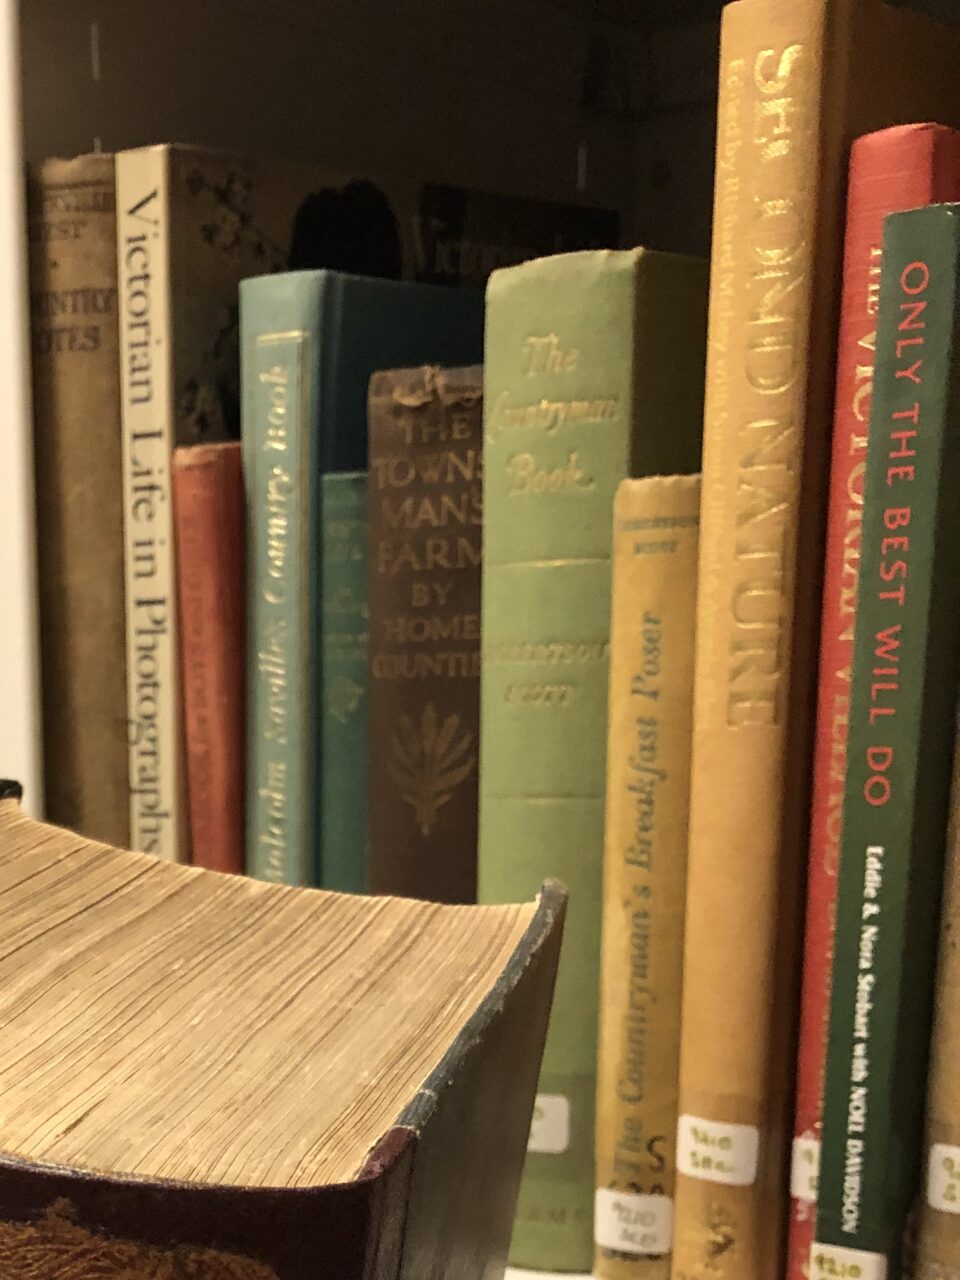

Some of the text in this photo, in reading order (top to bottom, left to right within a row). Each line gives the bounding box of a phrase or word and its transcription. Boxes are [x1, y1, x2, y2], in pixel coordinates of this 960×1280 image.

[522, 332, 579, 378] The
[507, 450, 596, 497] Book
[125, 188, 170, 859] Victorian Life in Photographs
[863, 260, 929, 806] ONLY THE BEST WILL DO
[411, 580, 456, 608] BY
[726, 414, 797, 731] NATURE
[613, 609, 668, 1174] The Countryman's Breakfast Poser
[862, 844, 886, 900] Eddie
[860, 901, 881, 920] &
[857, 924, 881, 969] Nora
[850, 1041, 871, 1081] with
[840, 1138, 866, 1235] DAVIDSON
